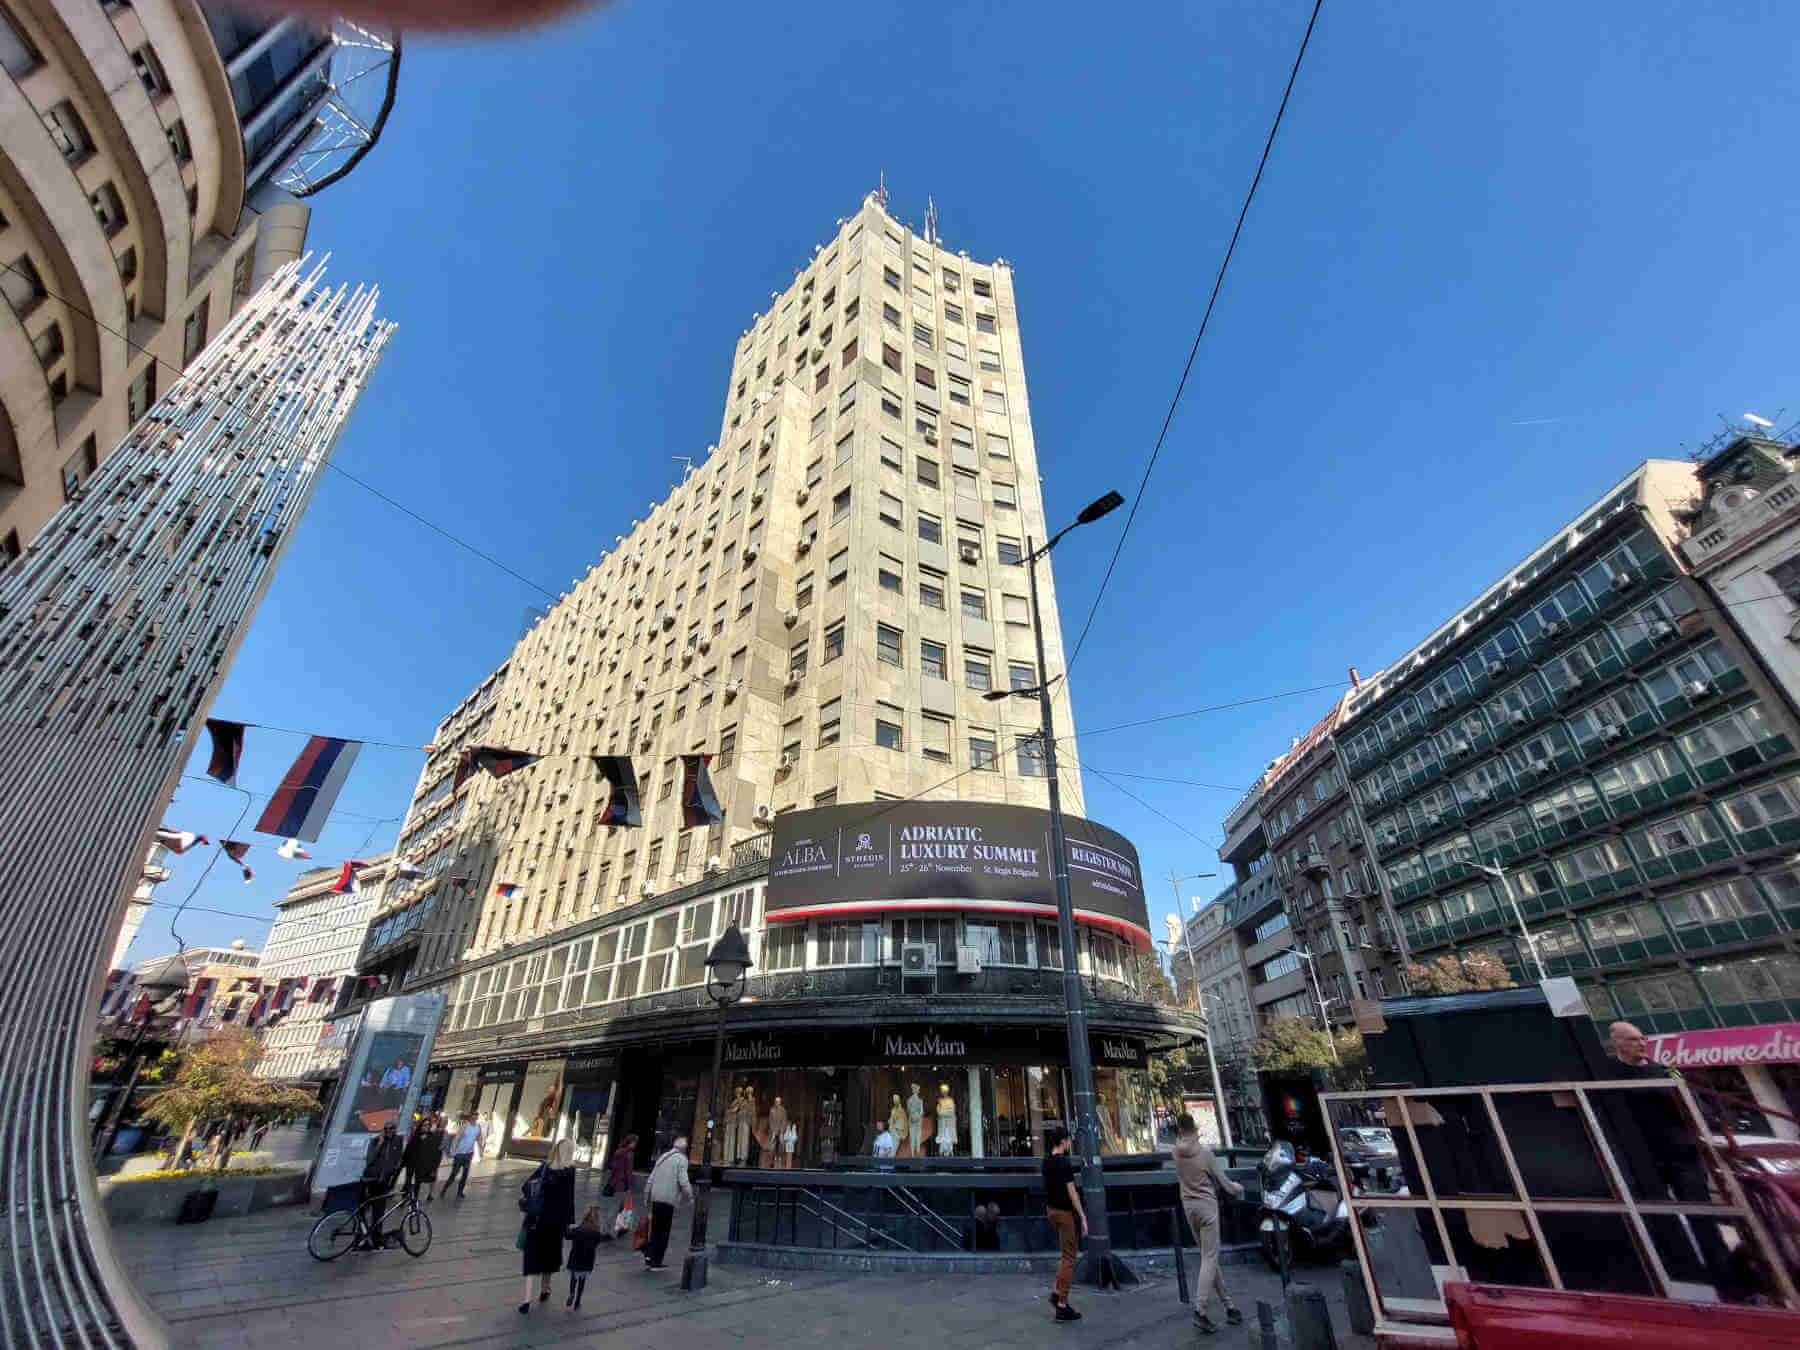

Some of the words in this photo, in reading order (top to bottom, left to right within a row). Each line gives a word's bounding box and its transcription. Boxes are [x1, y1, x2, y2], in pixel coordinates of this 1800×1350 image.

[900, 826, 983, 841] ADRIATIC
[900, 843, 968, 859] LUXURY
[973, 845, 1038, 864] SUMMIT
[725, 1038, 782, 1061] MaxMara
[884, 1034, 966, 1056] MaxMara
